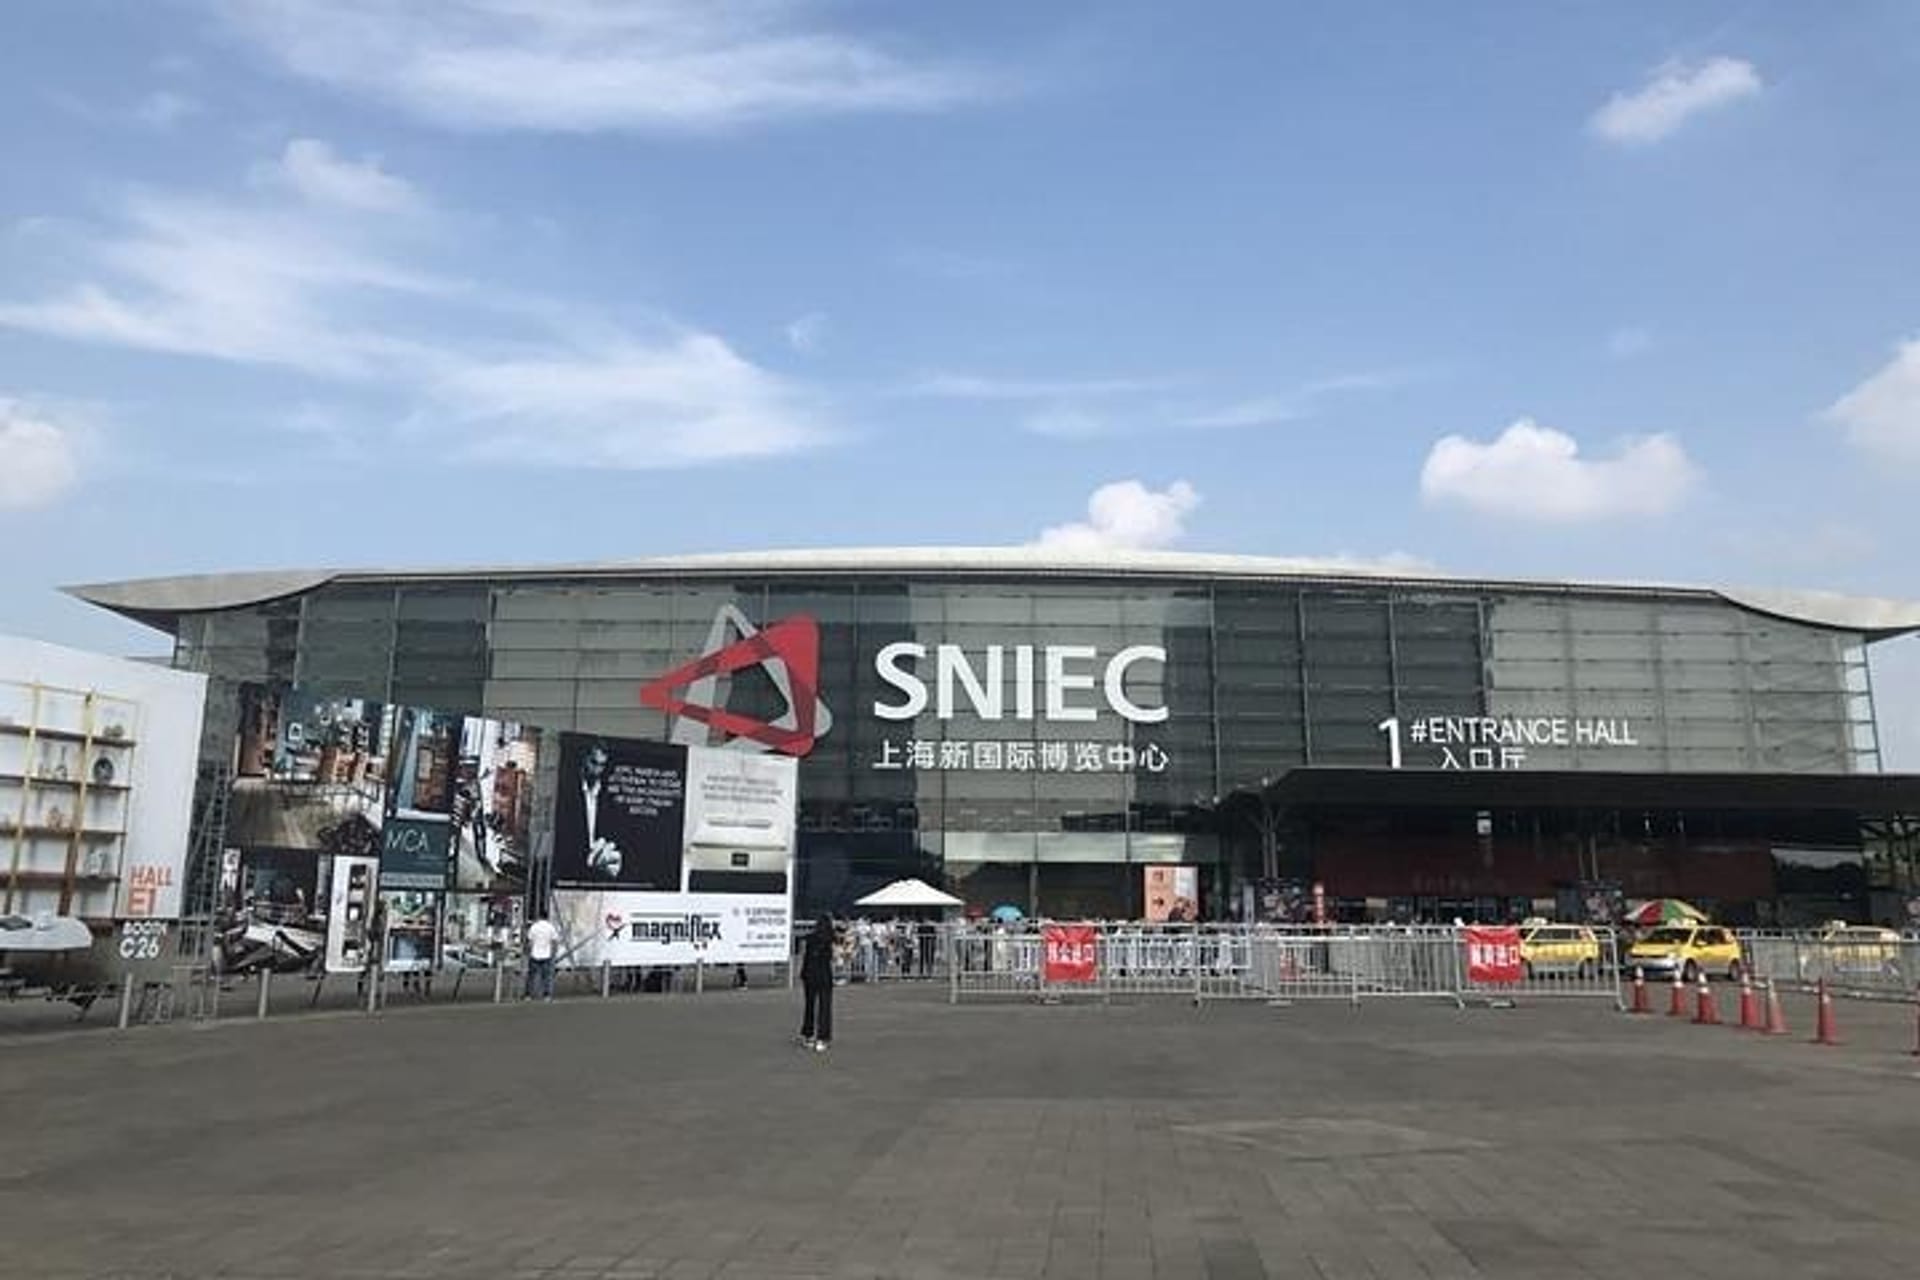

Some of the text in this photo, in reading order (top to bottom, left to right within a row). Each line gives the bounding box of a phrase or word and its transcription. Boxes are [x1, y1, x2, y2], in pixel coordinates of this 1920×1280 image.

[874, 642, 1169, 722] SNIEC
[872, 739, 1169, 772] 上海新国际博览中心
[1378, 717, 1638, 769] 1 #ENTRANCE HALL
[1441, 747, 1527, 769] 入口厅
[129, 864, 172, 887] HALL
[631, 913, 721, 944] magniflex
[120, 937, 159, 958] C26
